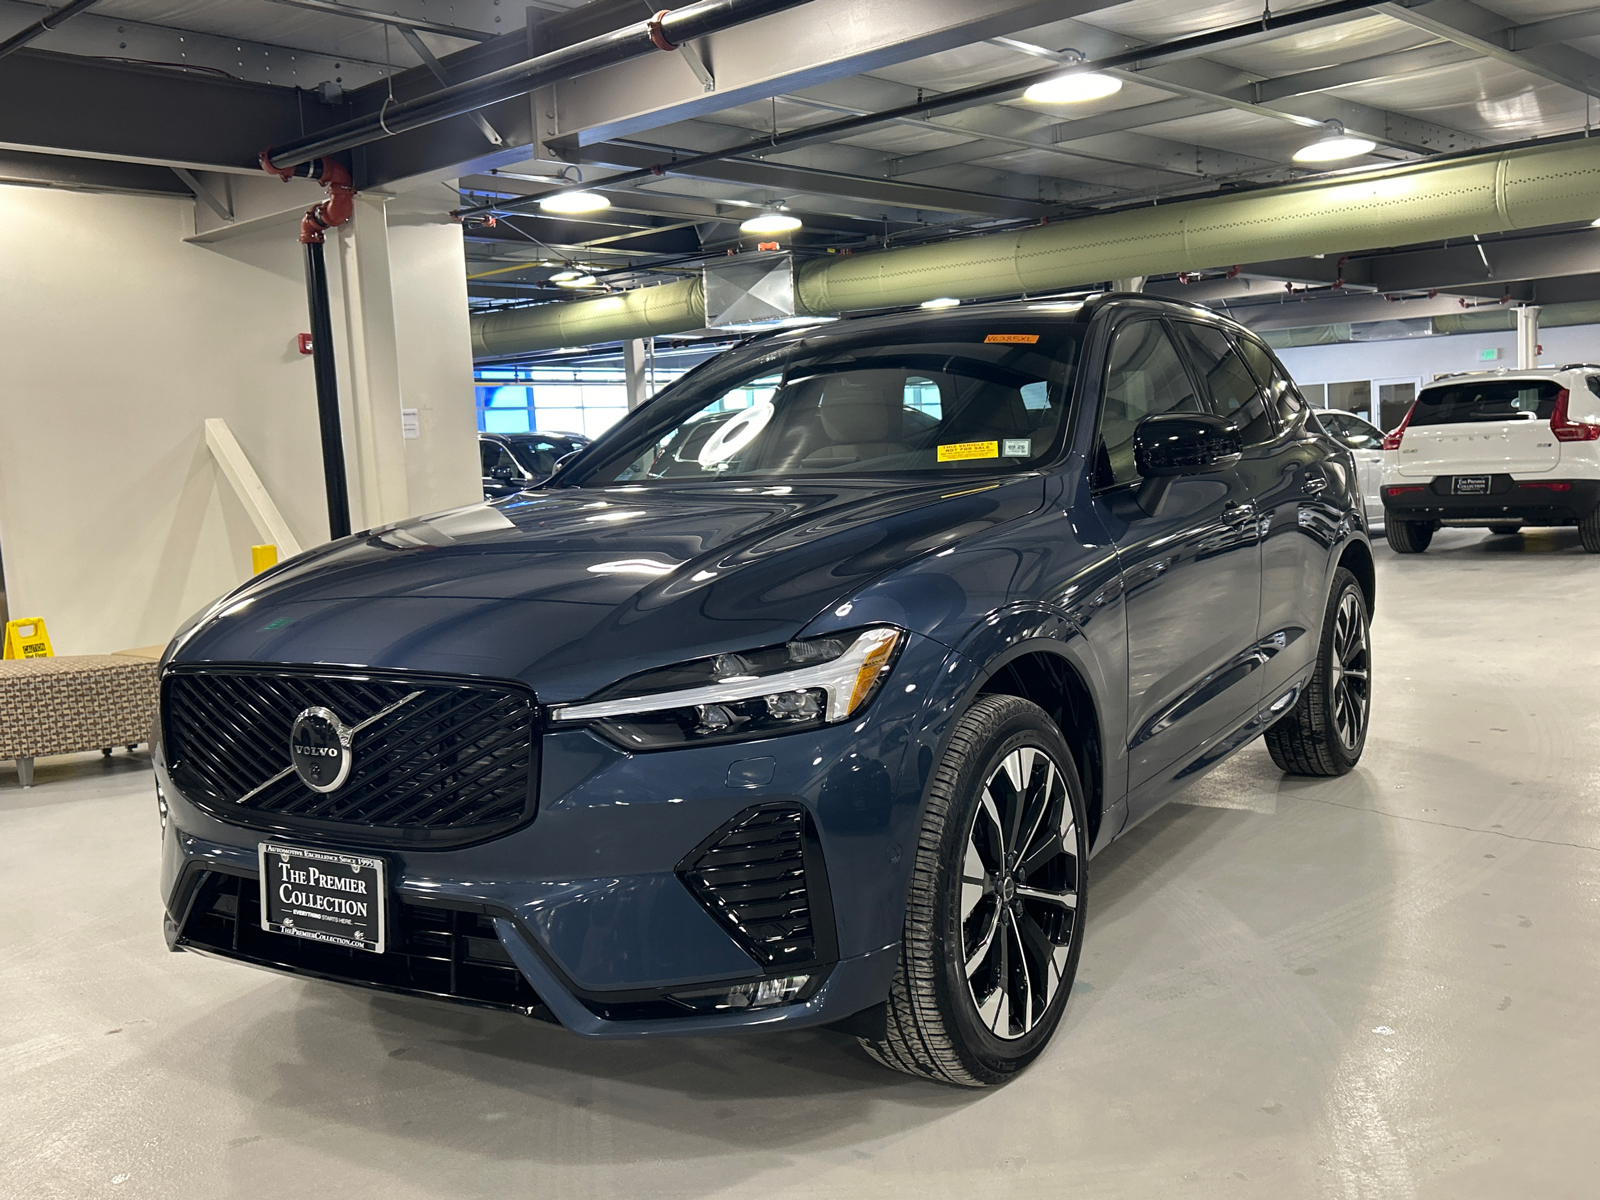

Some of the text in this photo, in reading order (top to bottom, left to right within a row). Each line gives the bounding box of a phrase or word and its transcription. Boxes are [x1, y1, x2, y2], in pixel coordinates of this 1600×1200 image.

[295, 745, 338, 757] VOLVO
[268, 846, 374, 867] AUTOMOTIVE EXCELLENCE SINCE 1995
[278, 862, 368, 894] THE PREMIER
[280, 884, 368, 917] COLLECTION
[292, 909, 322, 920] EVERYTHING
[322, 914, 339, 923] STARTS
